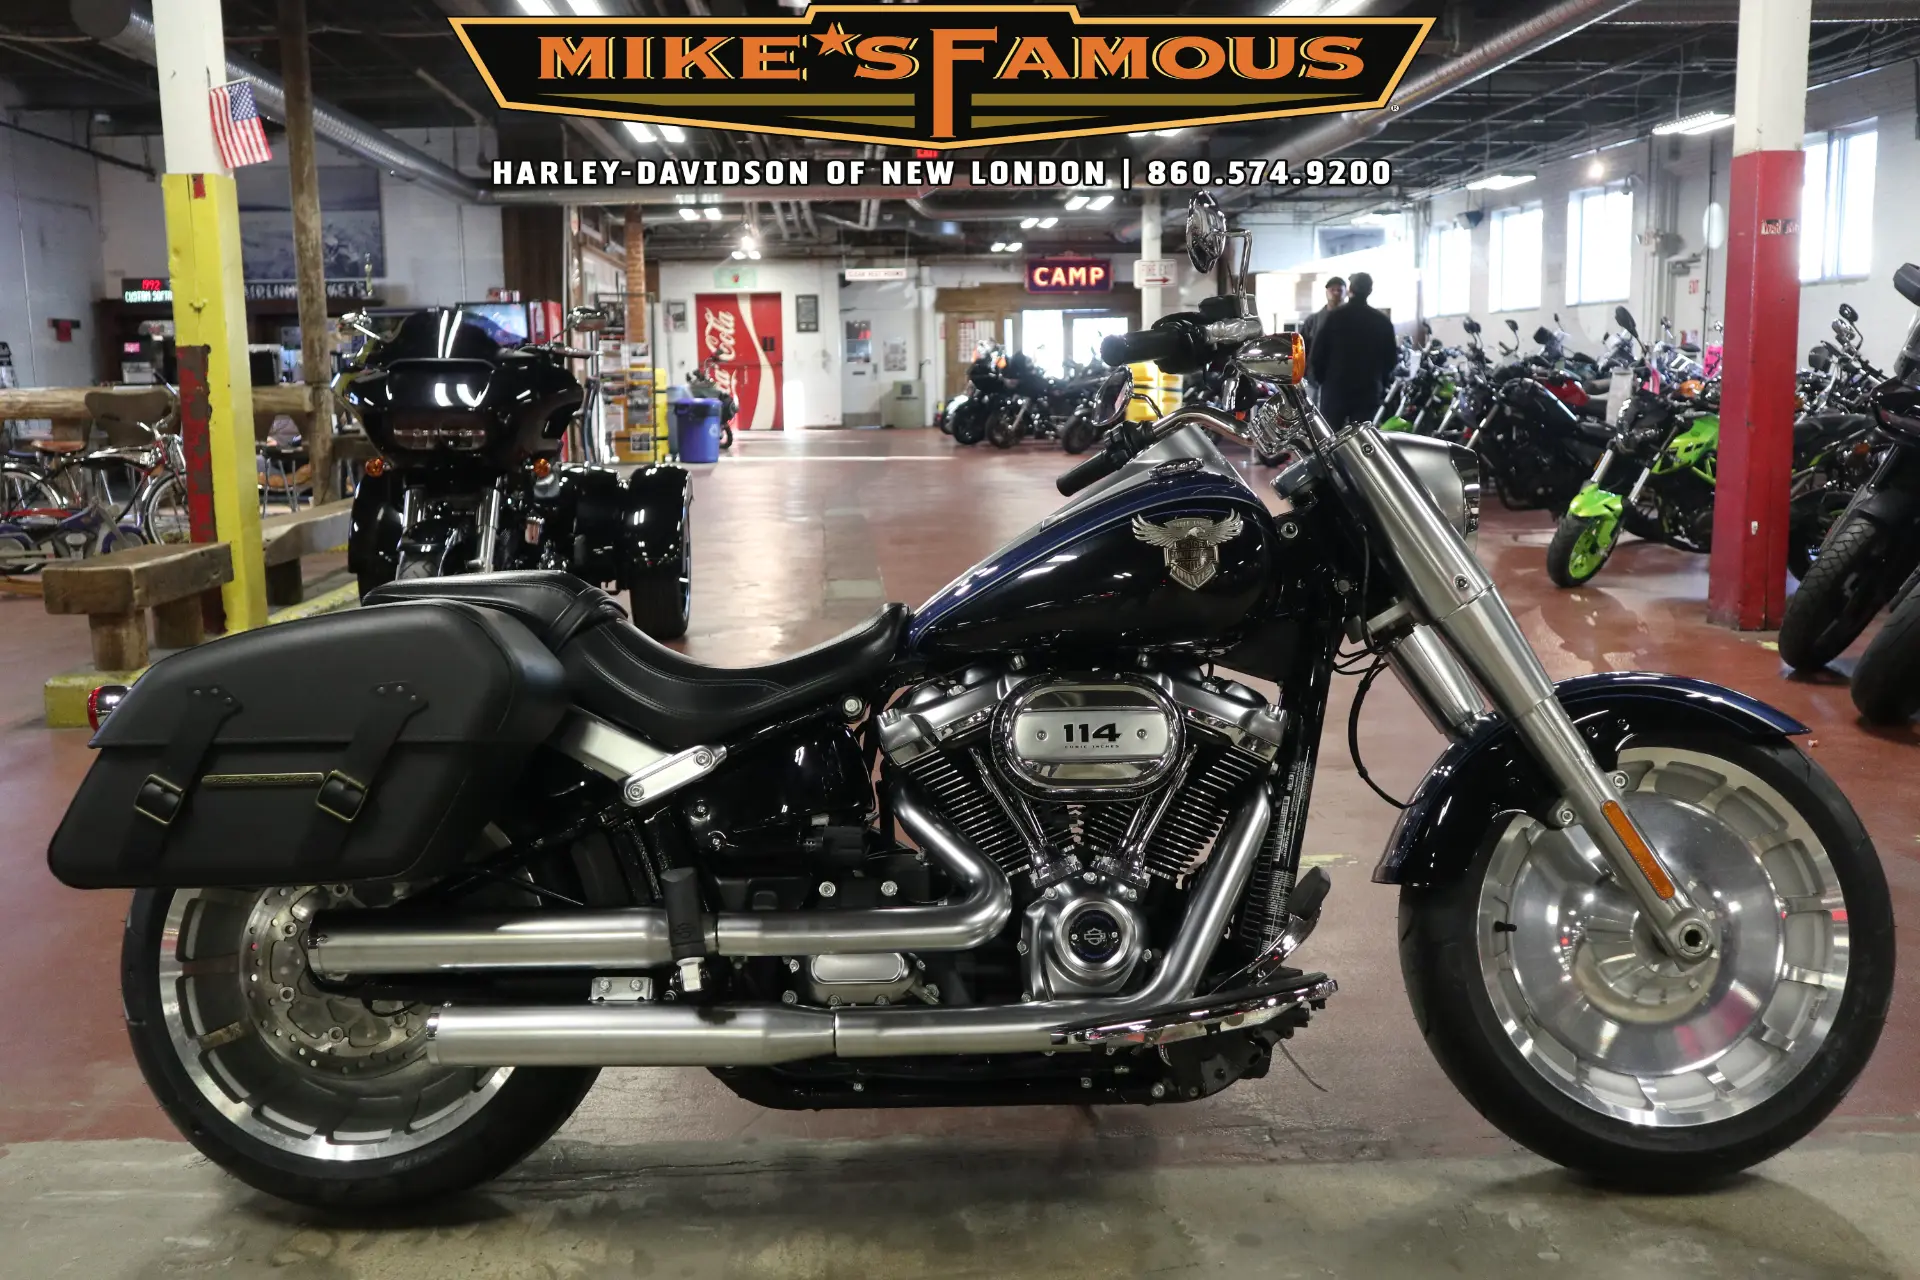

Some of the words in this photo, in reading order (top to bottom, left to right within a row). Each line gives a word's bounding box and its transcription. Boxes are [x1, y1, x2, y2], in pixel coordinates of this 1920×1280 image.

[1033, 266, 1105, 287] CAMP
[142, 279, 161, 290] 1992
[1688, 279, 1700, 294] EXIT
[125, 291, 151, 303] CUSTOM
[1063, 723, 1122, 742] 114
